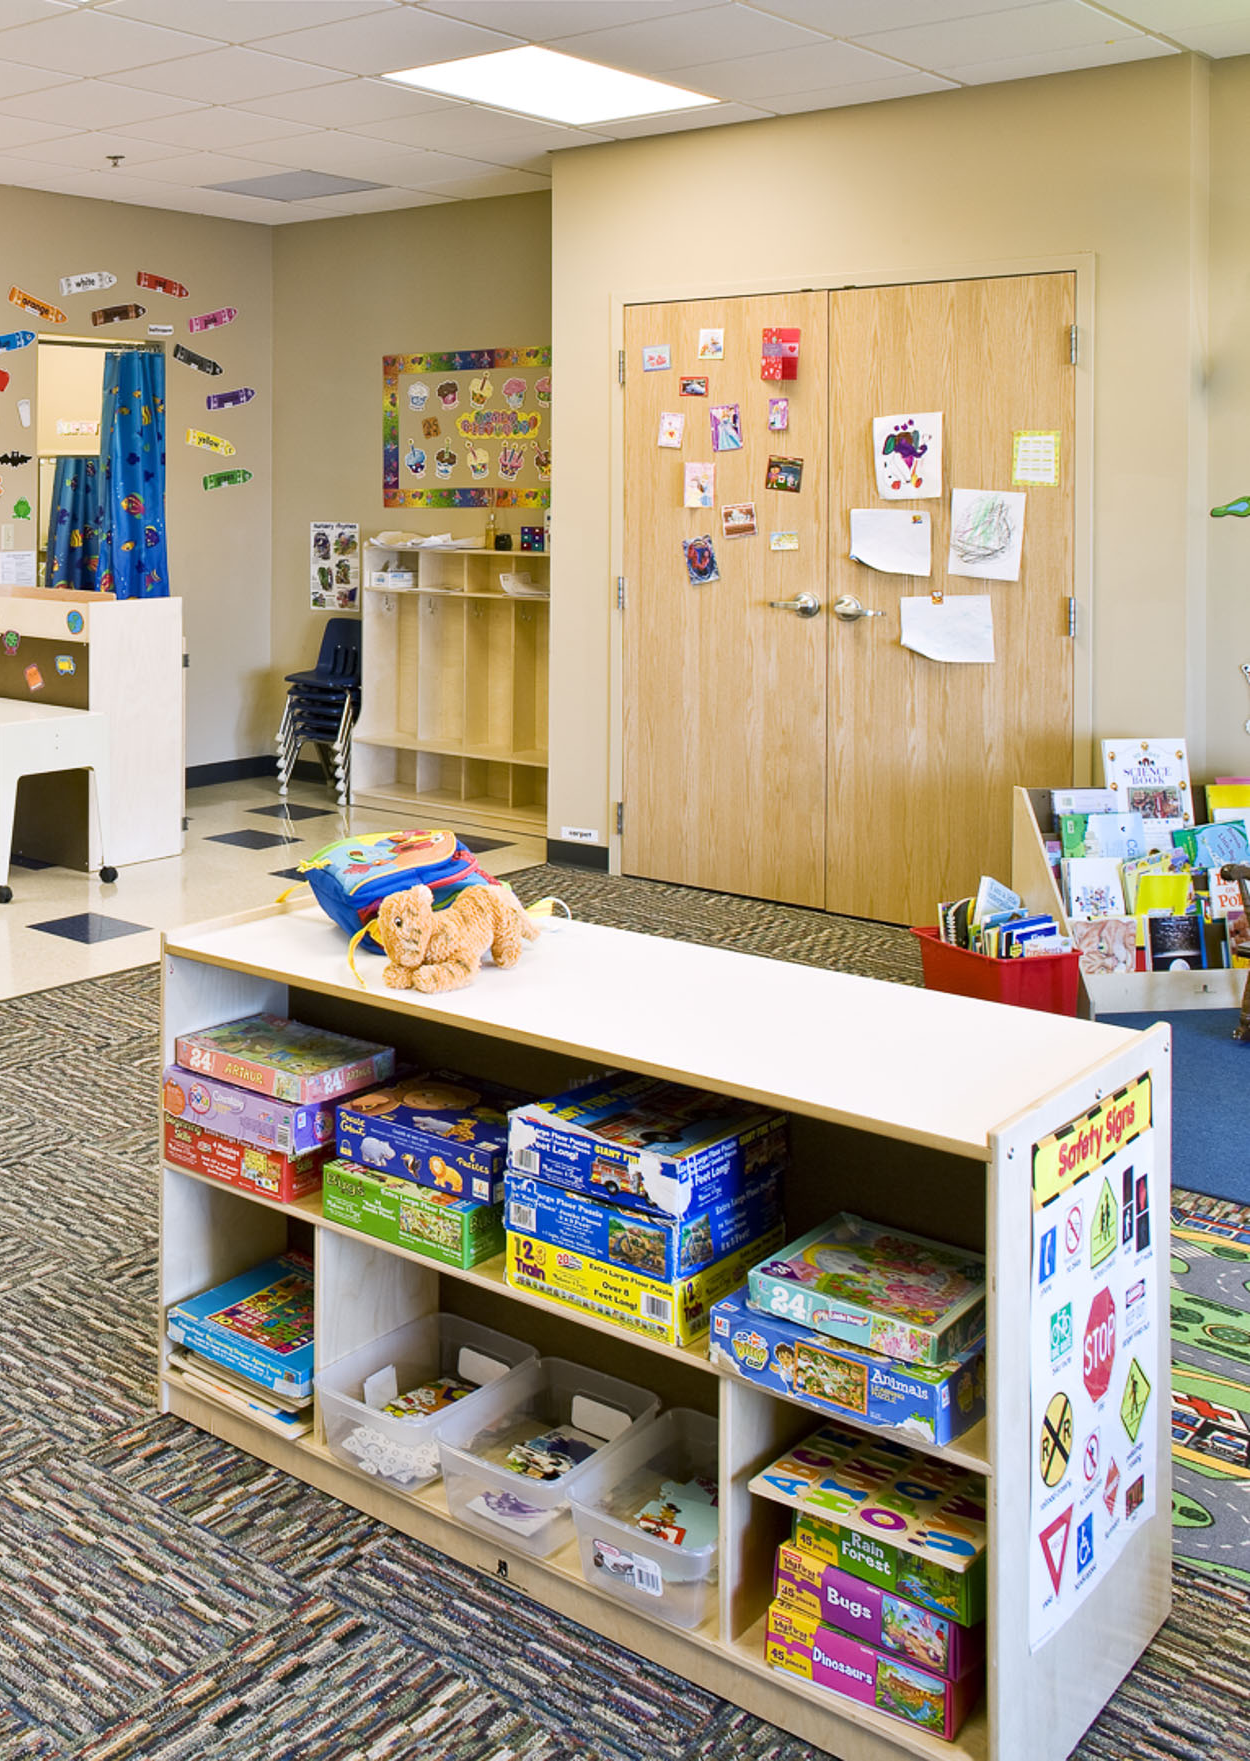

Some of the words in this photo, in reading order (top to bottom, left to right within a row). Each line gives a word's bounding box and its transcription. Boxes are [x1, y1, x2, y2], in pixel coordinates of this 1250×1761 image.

[21, 297, 50, 316] orange
[1123, 767, 1173, 776] SCIENCE
[1132, 776, 1166, 784] BOOK
[190, 1047, 212, 1072] 24
[224, 1062, 263, 1085] ARTHUR
[323, 1070, 343, 1095] 24
[1058, 1124, 1103, 1177] Safety
[1106, 1100, 1136, 1144] Signs
[552, 1146, 579, 1161] Long!
[594, 1145, 622, 1161] GIANT
[380, 1188, 399, 1201] Extra
[399, 1195, 419, 1209] Large
[420, 1201, 439, 1214] Floor
[438, 1208, 462, 1221] Puzzle
[515, 1257, 546, 1281] Train
[556, 1253, 569, 1265] 20
[589, 1263, 608, 1275] Extra
[608, 1269, 629, 1283] Large
[630, 1275, 649, 1289] Floor
[649, 1283, 674, 1297] Puzzle
[602, 1281, 622, 1294] Over
[593, 1289, 613, 1302] Feet
[614, 1295, 638, 1311] Long!
[770, 1286, 807, 1322] 24
[1083, 1313, 1116, 1377] STOP
[869, 1368, 930, 1400] Animals
[1063, 1418, 1071, 1443] R
[791, 1450, 834, 1468] C
[1041, 1436, 1050, 1462] R
[773, 1460, 820, 1482] B
[844, 1458, 895, 1482] K
[762, 1474, 810, 1497] A
[820, 1478, 869, 1501] I
[805, 1490, 857, 1516] H
[860, 1508, 908, 1531] O
[923, 1512, 976, 1538] V
[800, 1533, 813, 1547] 45
[851, 1532, 884, 1560] Rain
[924, 1530, 976, 1556] U
[841, 1540, 892, 1575] Forest
[826, 1586, 872, 1620] Bugs
[771, 1647, 785, 1661] 45
[812, 1645, 874, 1686] Dinosaurs
